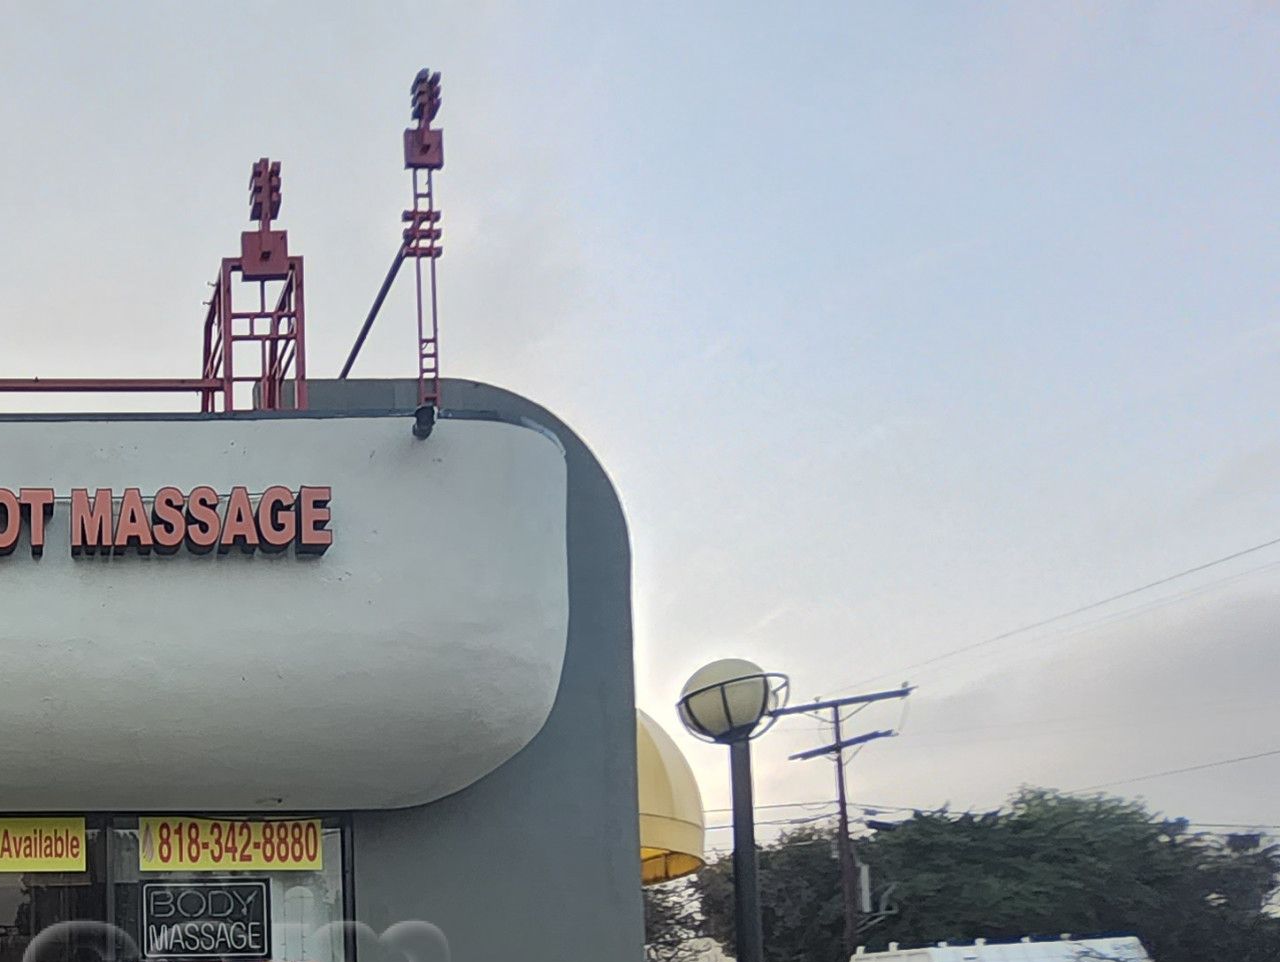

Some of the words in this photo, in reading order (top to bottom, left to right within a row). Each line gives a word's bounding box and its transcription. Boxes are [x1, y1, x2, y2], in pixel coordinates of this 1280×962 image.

[70, 485, 333, 551] MASSAGE
[0, 828, 81, 860] Available
[158, 821, 318, 864] 818-342-8880
[149, 890, 258, 917] BODY
[149, 922, 262, 951] MASSAGE
